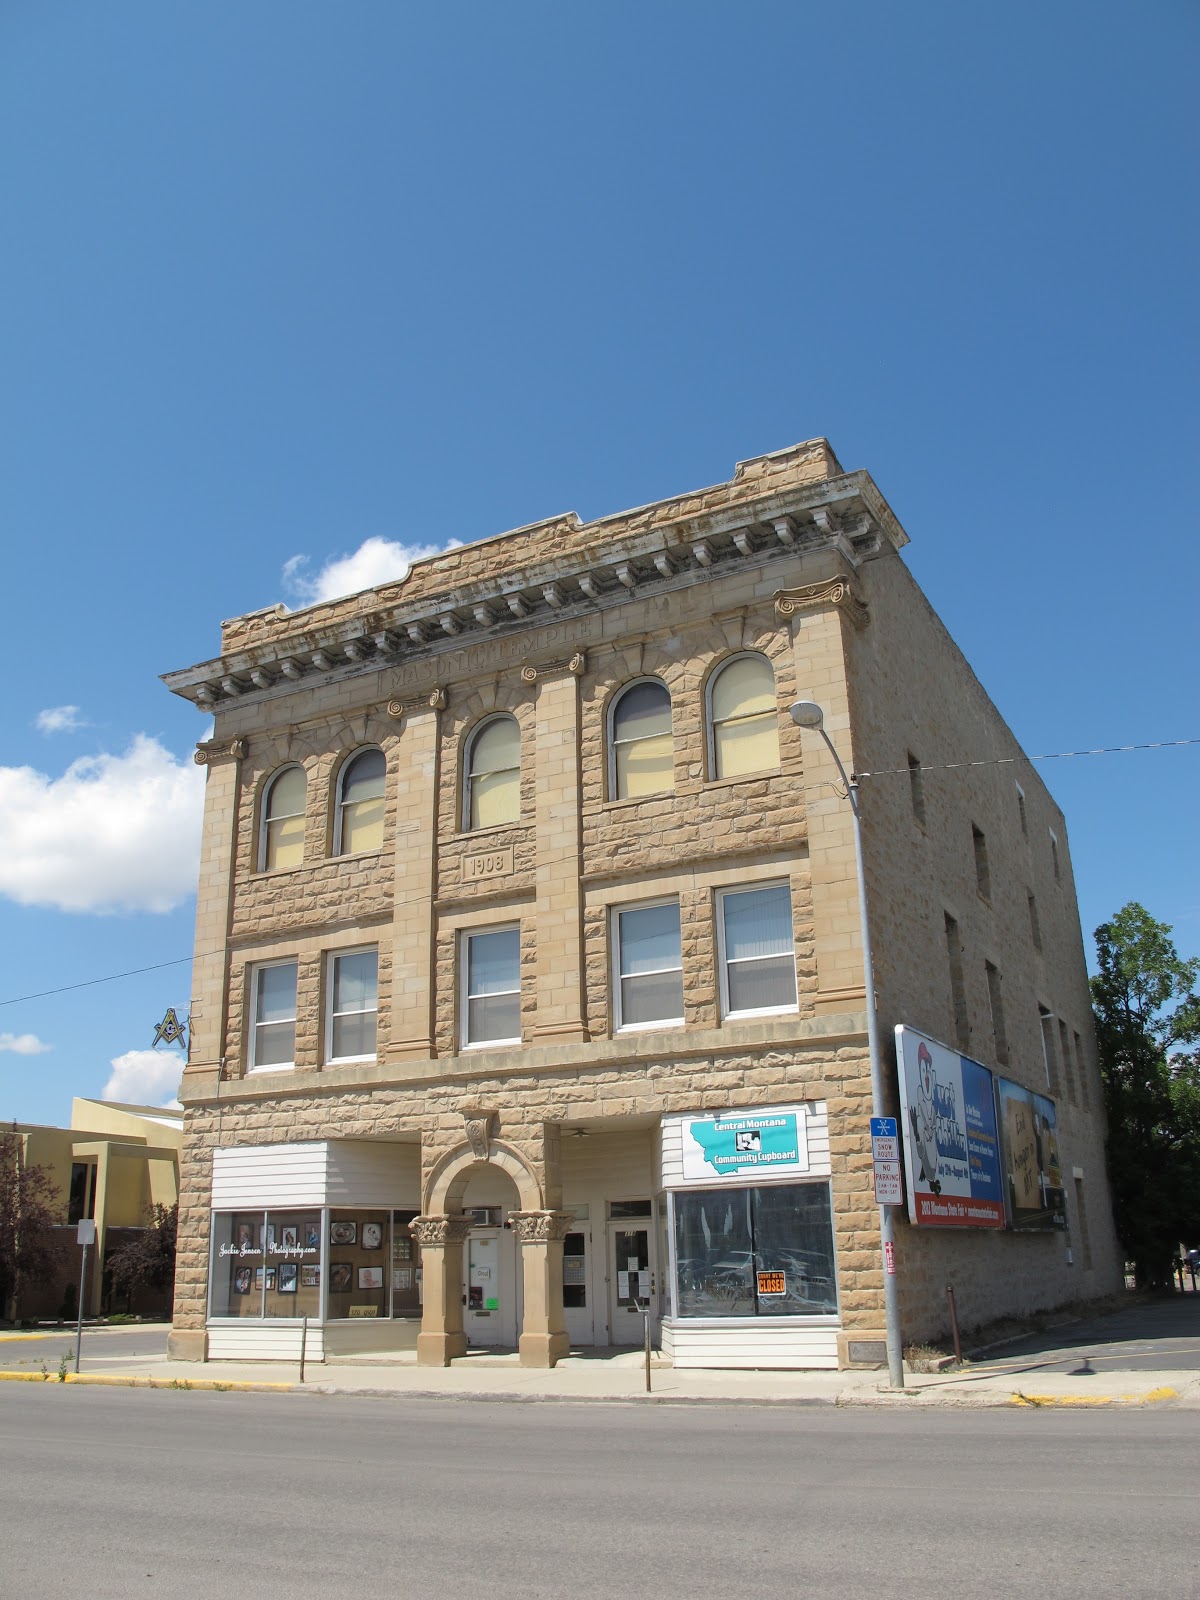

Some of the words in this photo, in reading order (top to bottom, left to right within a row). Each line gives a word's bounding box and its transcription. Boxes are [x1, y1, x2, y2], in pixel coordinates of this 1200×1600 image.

[389, 648, 487, 689] MASONIC
[491, 618, 592, 659] TEMPLE
[471, 856, 504, 876] 1908
[714, 1120, 746, 1131] Central
[747, 1118, 787, 1129] Montana
[714, 1153, 758, 1165] Community
[758, 1149, 796, 1163] Cupboard
[882, 1164, 891, 1172] NO
[875, 1173, 899, 1182] PARKING
[219, 1242, 240, 1258] Jackie
[240, 1242, 262, 1258] Jensen
[269, 1241, 317, 1259] Photography.com
[759, 1279, 785, 1292] CLOSED
